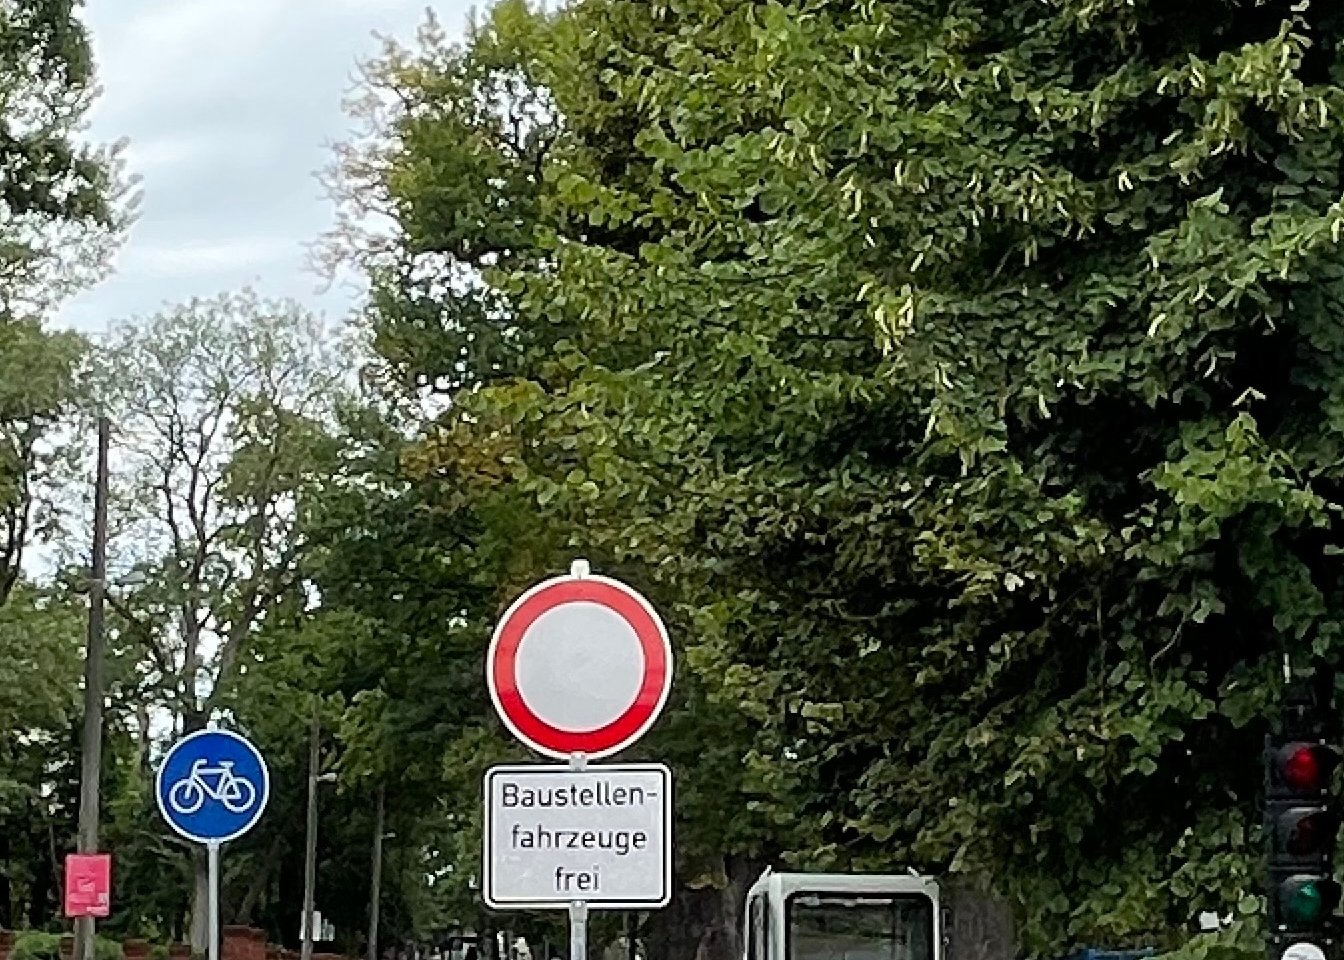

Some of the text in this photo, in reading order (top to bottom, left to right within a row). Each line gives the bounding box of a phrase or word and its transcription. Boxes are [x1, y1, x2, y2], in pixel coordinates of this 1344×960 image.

[502, 781, 658, 808] Baustellen-
[512, 824, 648, 856] fahrzeuge
[554, 865, 600, 891] frei
